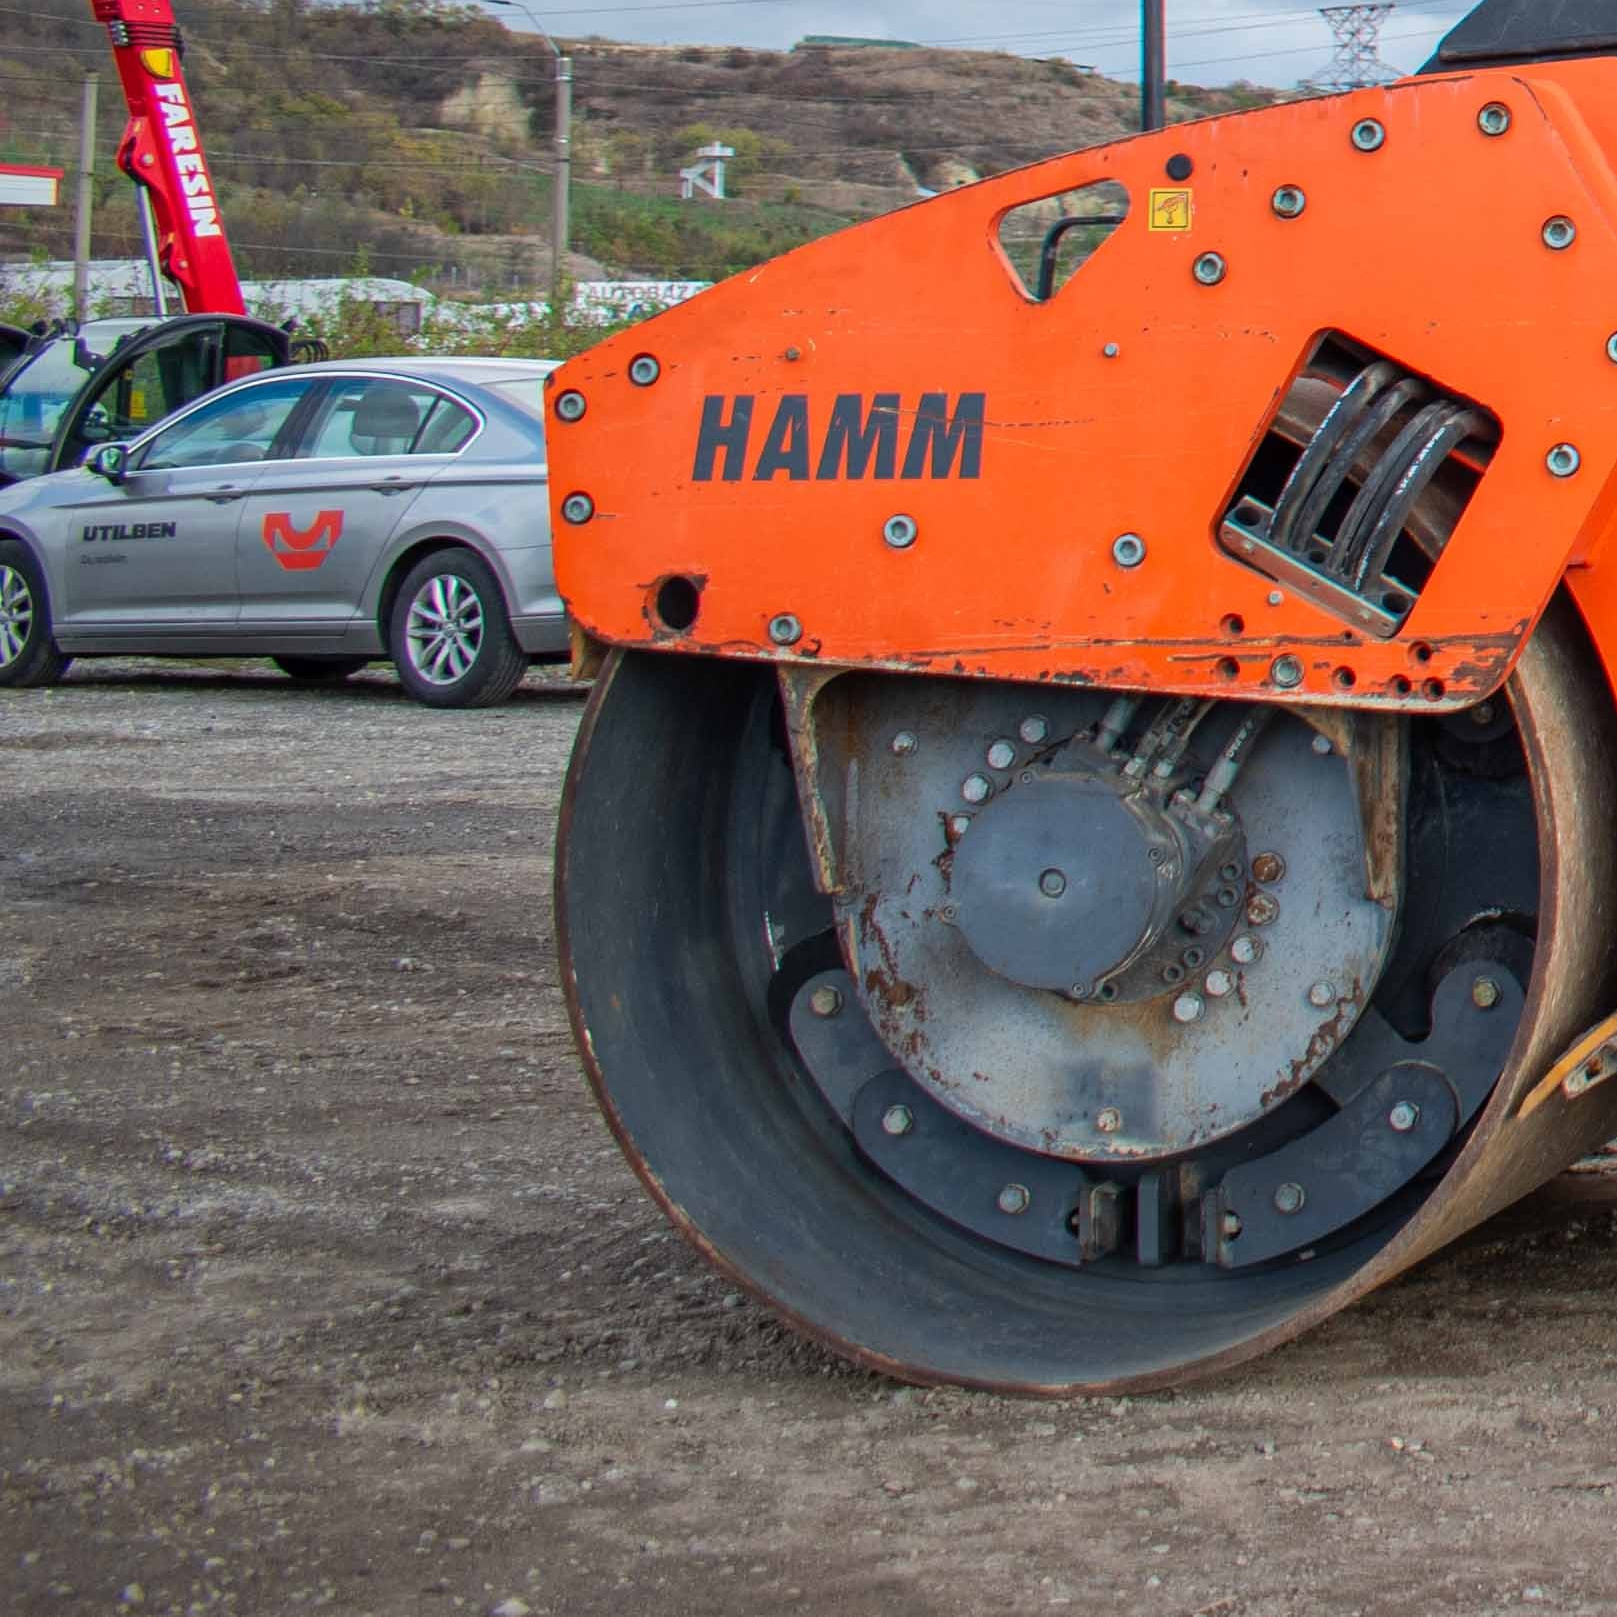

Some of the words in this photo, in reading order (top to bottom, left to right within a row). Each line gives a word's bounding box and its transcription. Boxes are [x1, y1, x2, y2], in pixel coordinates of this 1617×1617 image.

[153, 82, 222, 238] FARESIN
[692, 393, 986, 481] HAMM
[83, 521, 177, 542] UTILBEN
